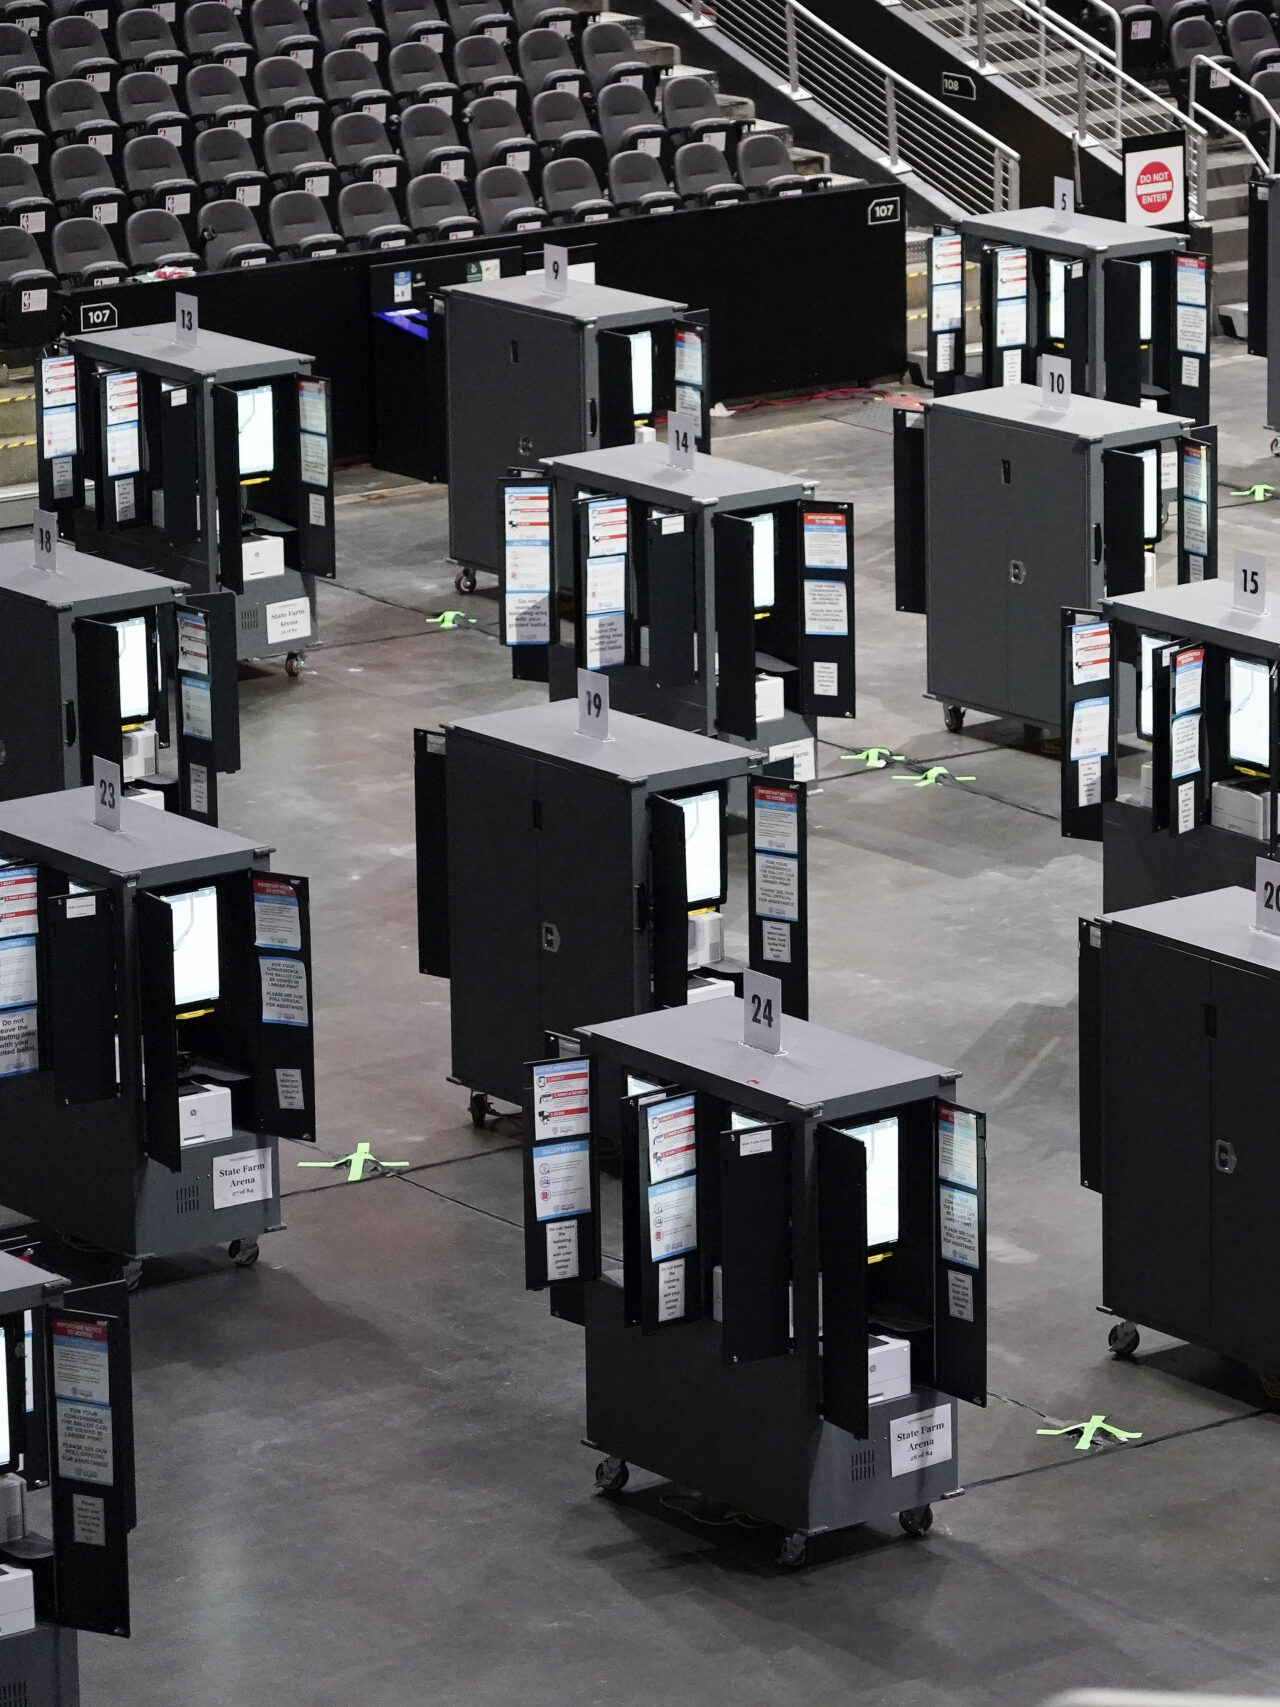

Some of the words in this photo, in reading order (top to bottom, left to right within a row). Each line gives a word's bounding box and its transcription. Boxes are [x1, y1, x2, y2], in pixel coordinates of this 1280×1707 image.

[944, 78, 959, 91] 108
[1140, 173, 1152, 184] DO
[1152, 171, 1169, 182] NOT
[1061, 193, 1067, 211] 5
[1142, 192, 1168, 205] ENTER
[874, 204, 894, 217] 107
[553, 260, 559, 280] 9
[88, 309, 110, 324] 107
[181, 309, 193, 331] 13
[1049, 371, 1064, 394] 10
[675, 429, 689, 453] 14
[39, 527, 52, 553] 18
[1242, 568, 1259, 594] 15
[586, 690, 602, 718] 19
[100, 779, 115, 809] 23
[751, 994, 774, 1028] 24
[219, 1168, 241, 1177] State
[242, 1163, 265, 1173] Farm
[229, 1177, 255, 1188] Arena
[896, 1430, 919, 1441] State
[921, 1422, 945, 1434] Farm
[908, 1439, 934, 1452] Arena
